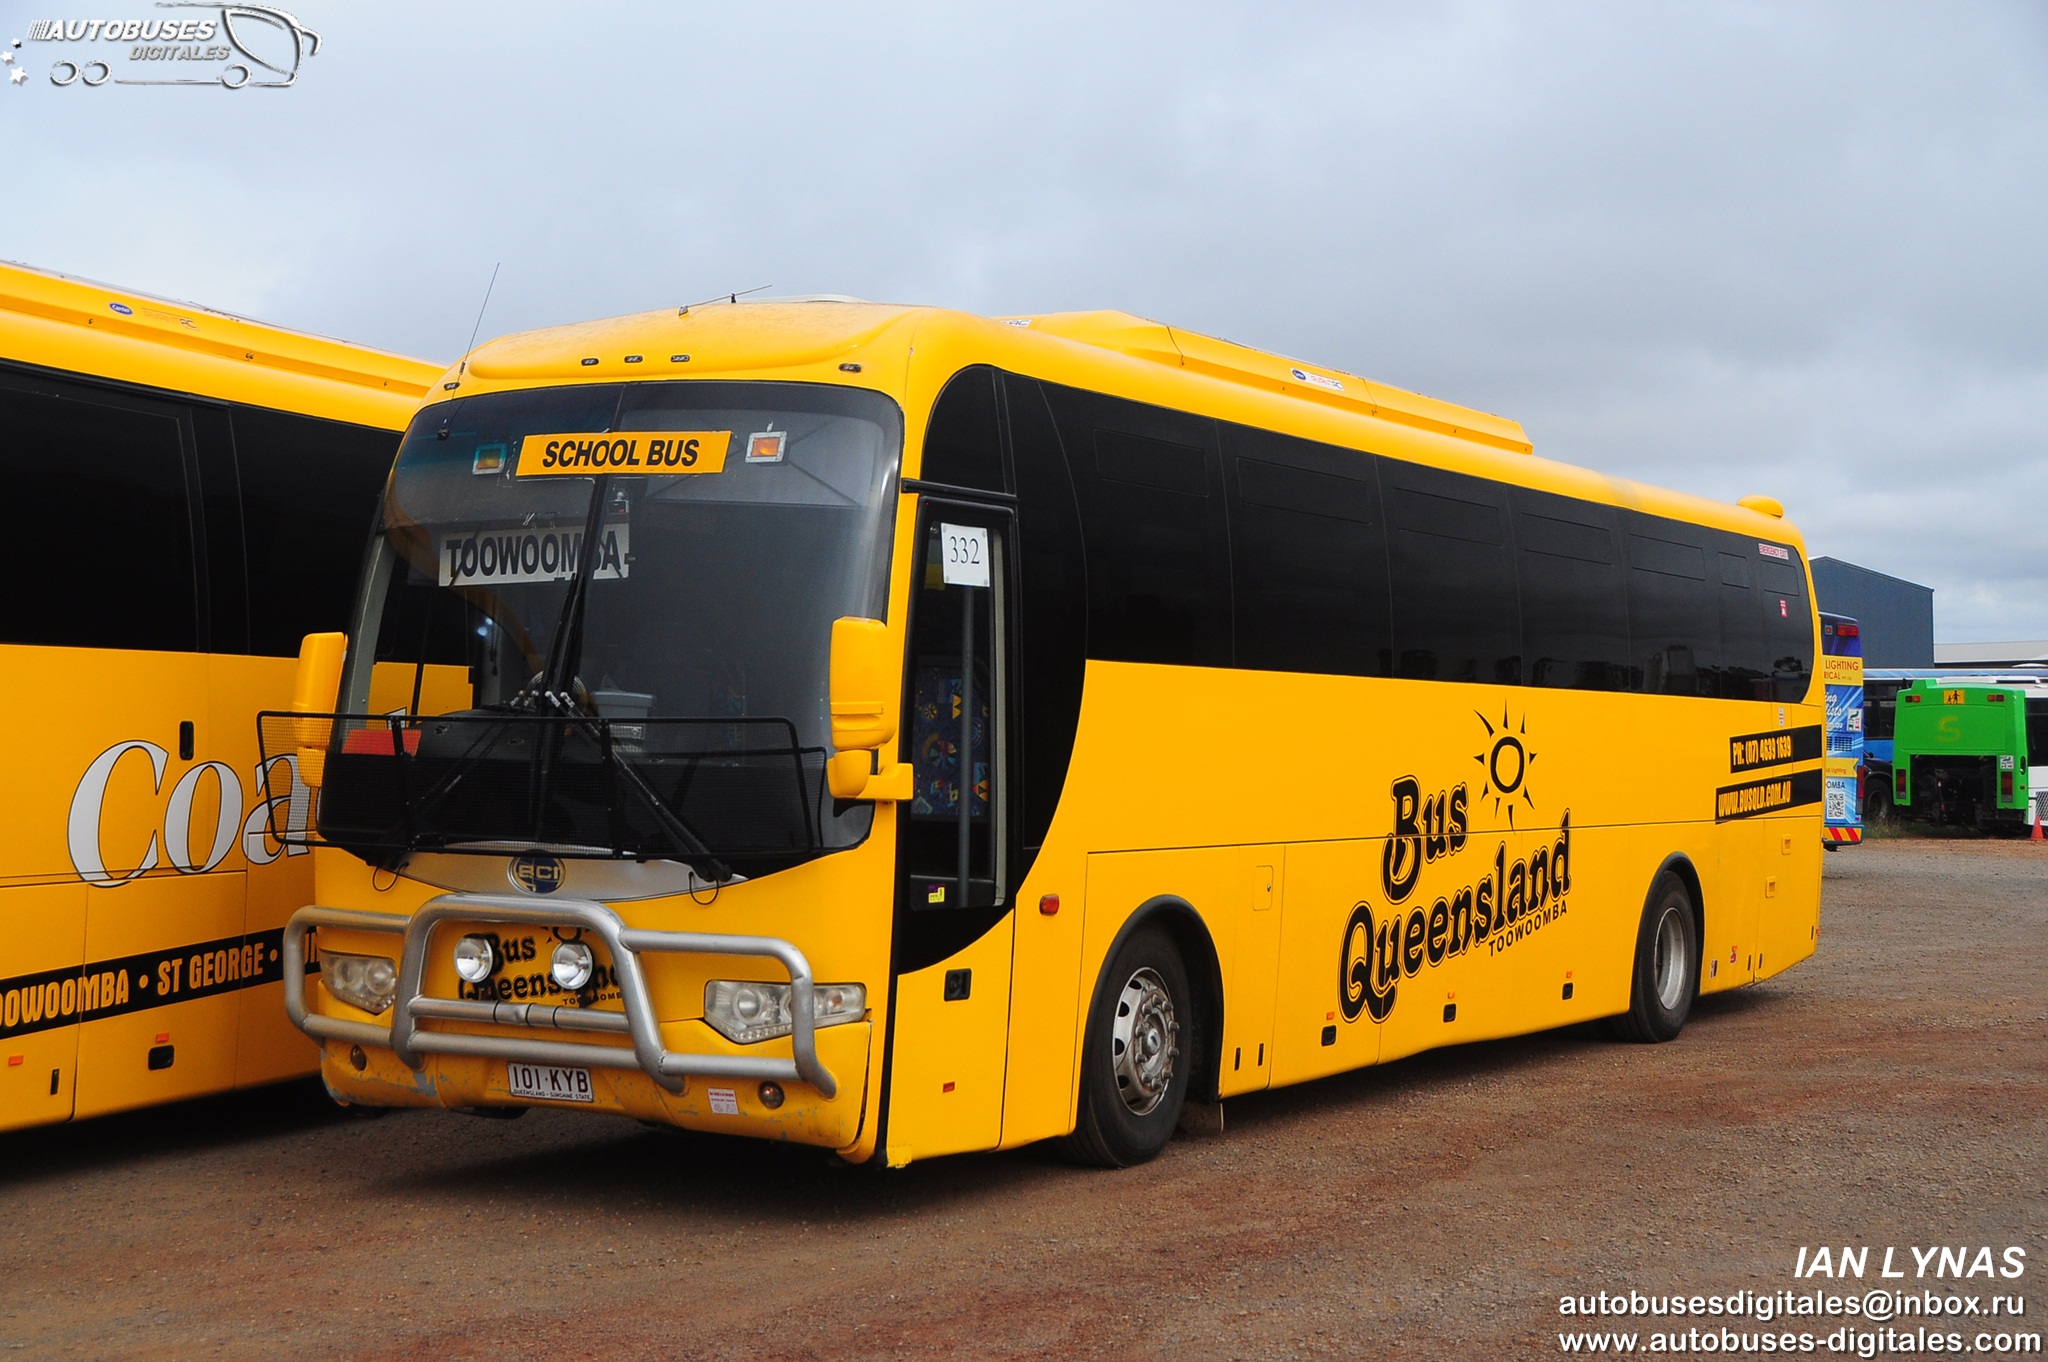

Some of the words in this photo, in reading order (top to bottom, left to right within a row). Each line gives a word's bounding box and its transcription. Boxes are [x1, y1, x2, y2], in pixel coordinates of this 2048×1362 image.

[542, 439, 641, 468] SCHOOL
[645, 439, 700, 467] BUS
[446, 530, 621, 578] TOOWOOMA
[949, 536, 980, 565] 332
[1824, 671, 1840, 680] RICAL
[1825, 660, 1859, 671] LIGHTING
[1826, 781, 1845, 790] OMBA
[67, 739, 320, 888] Coa
[1381, 775, 1468, 905] Bus
[518, 865, 561, 880] BCI
[1337, 808, 1571, 1024] Queensland
[1489, 900, 1568, 957] TOOWOOMBA
[0, 969, 129, 1027] OWOOMBA
[157, 958, 183, 996] ST
[189, 942, 264, 989] GEORGE
